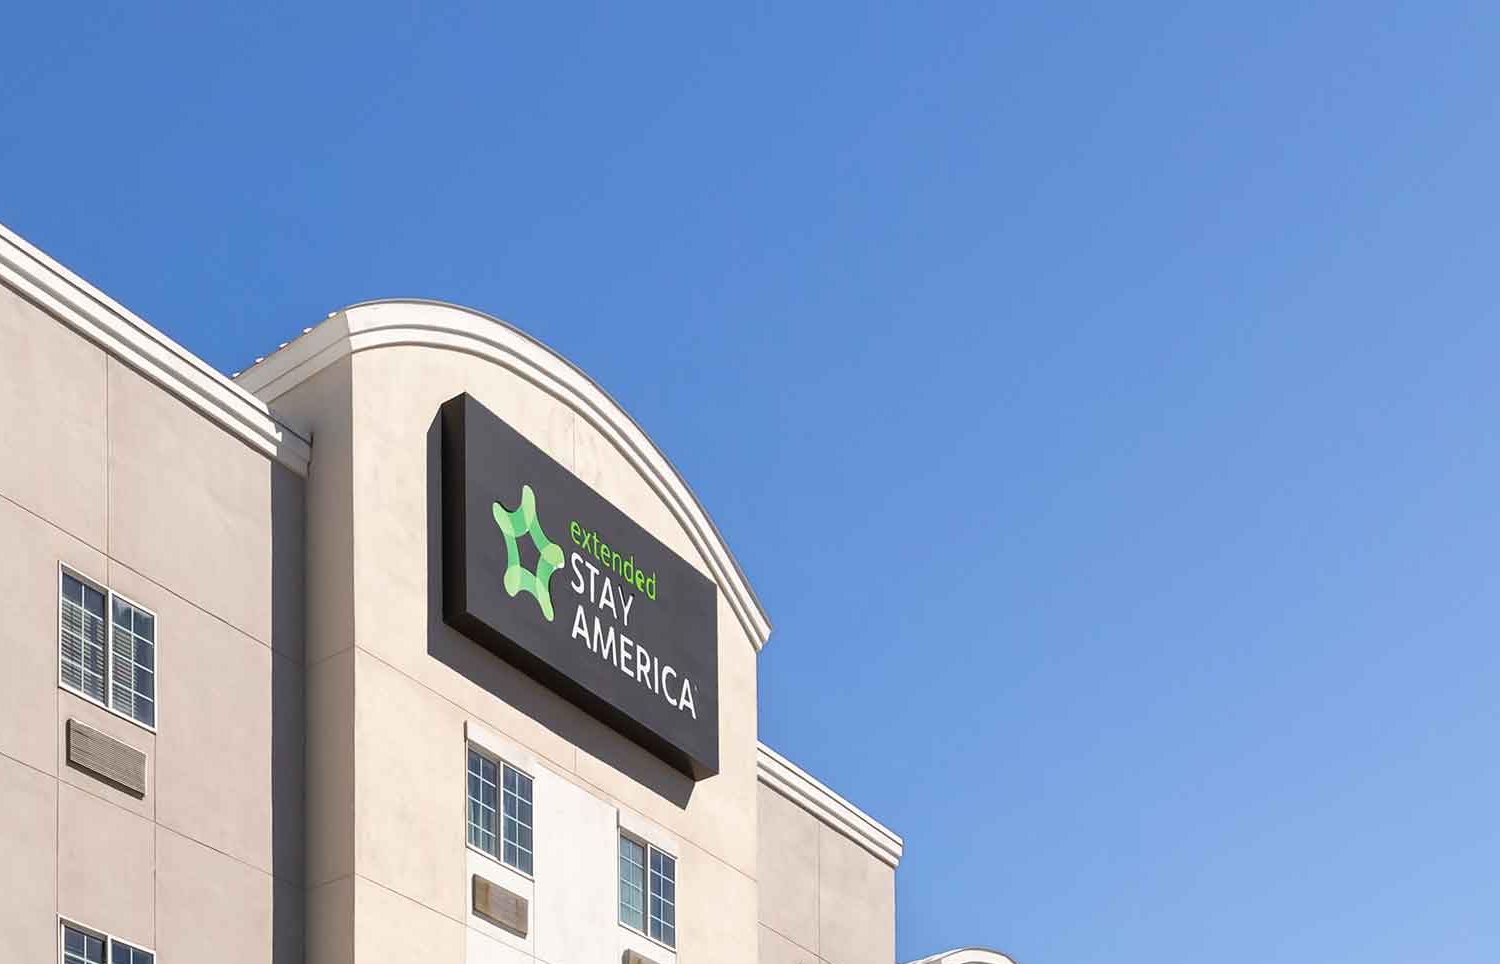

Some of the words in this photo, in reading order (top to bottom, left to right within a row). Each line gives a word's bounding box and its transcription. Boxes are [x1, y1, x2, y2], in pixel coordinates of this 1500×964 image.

[570, 521, 656, 601] extended
[571, 553, 634, 626] STAY
[571, 605, 697, 720] AMERICA
